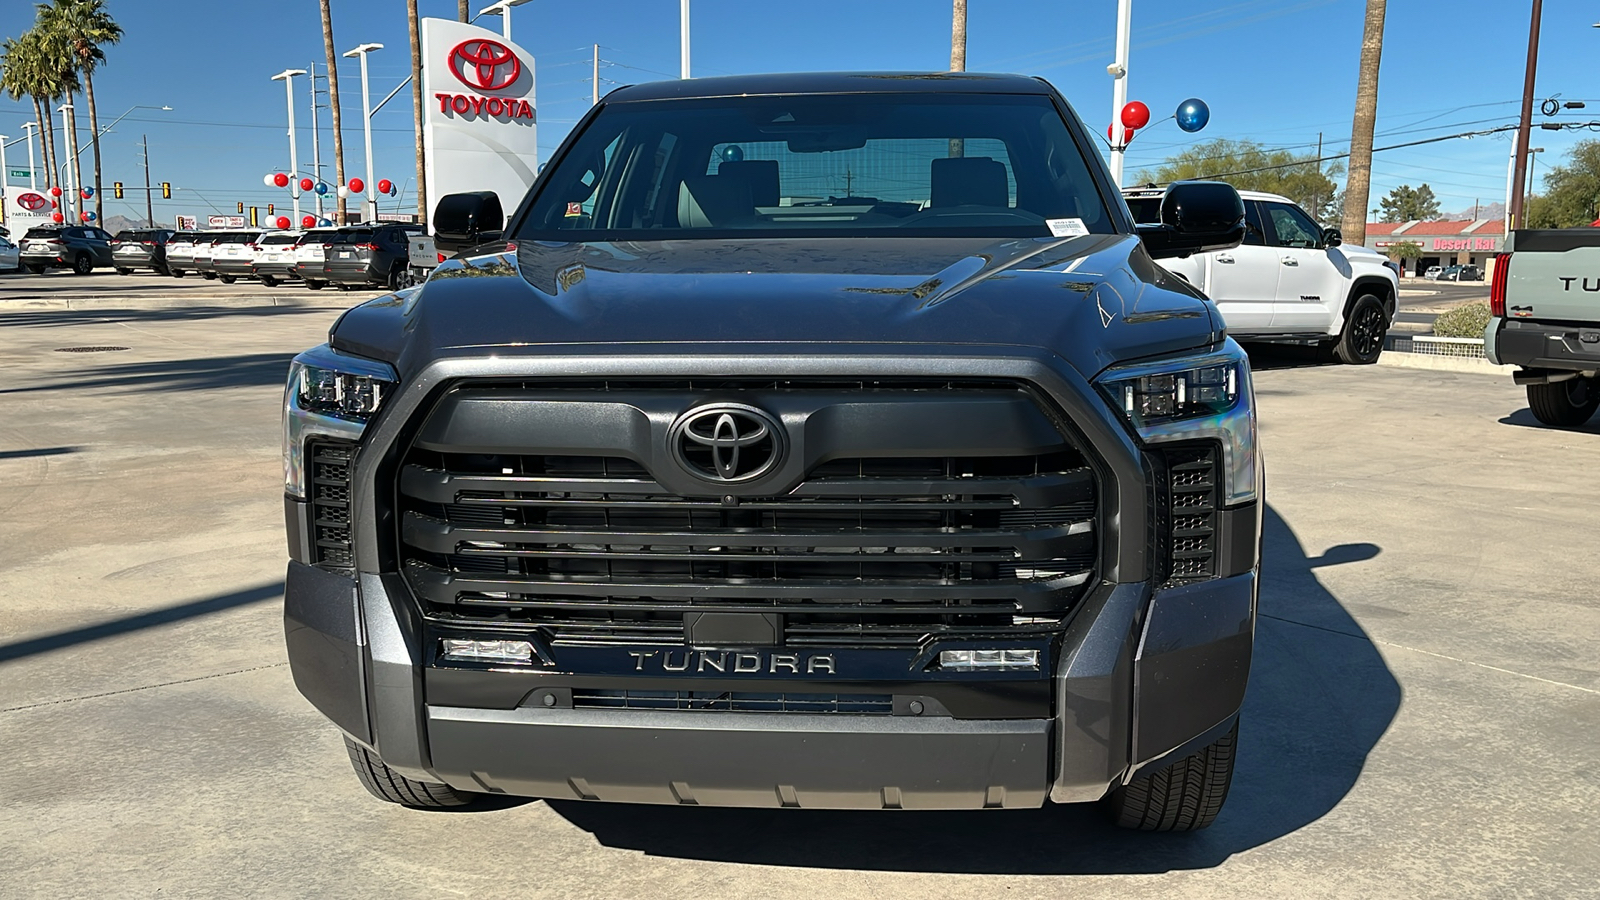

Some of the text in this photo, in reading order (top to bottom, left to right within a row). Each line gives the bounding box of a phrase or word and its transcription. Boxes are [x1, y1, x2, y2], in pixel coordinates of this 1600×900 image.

[435, 93, 533, 119] TOYOTA
[1433, 238, 1495, 250] Desert Rat
[628, 650, 836, 674] TUNDRA
